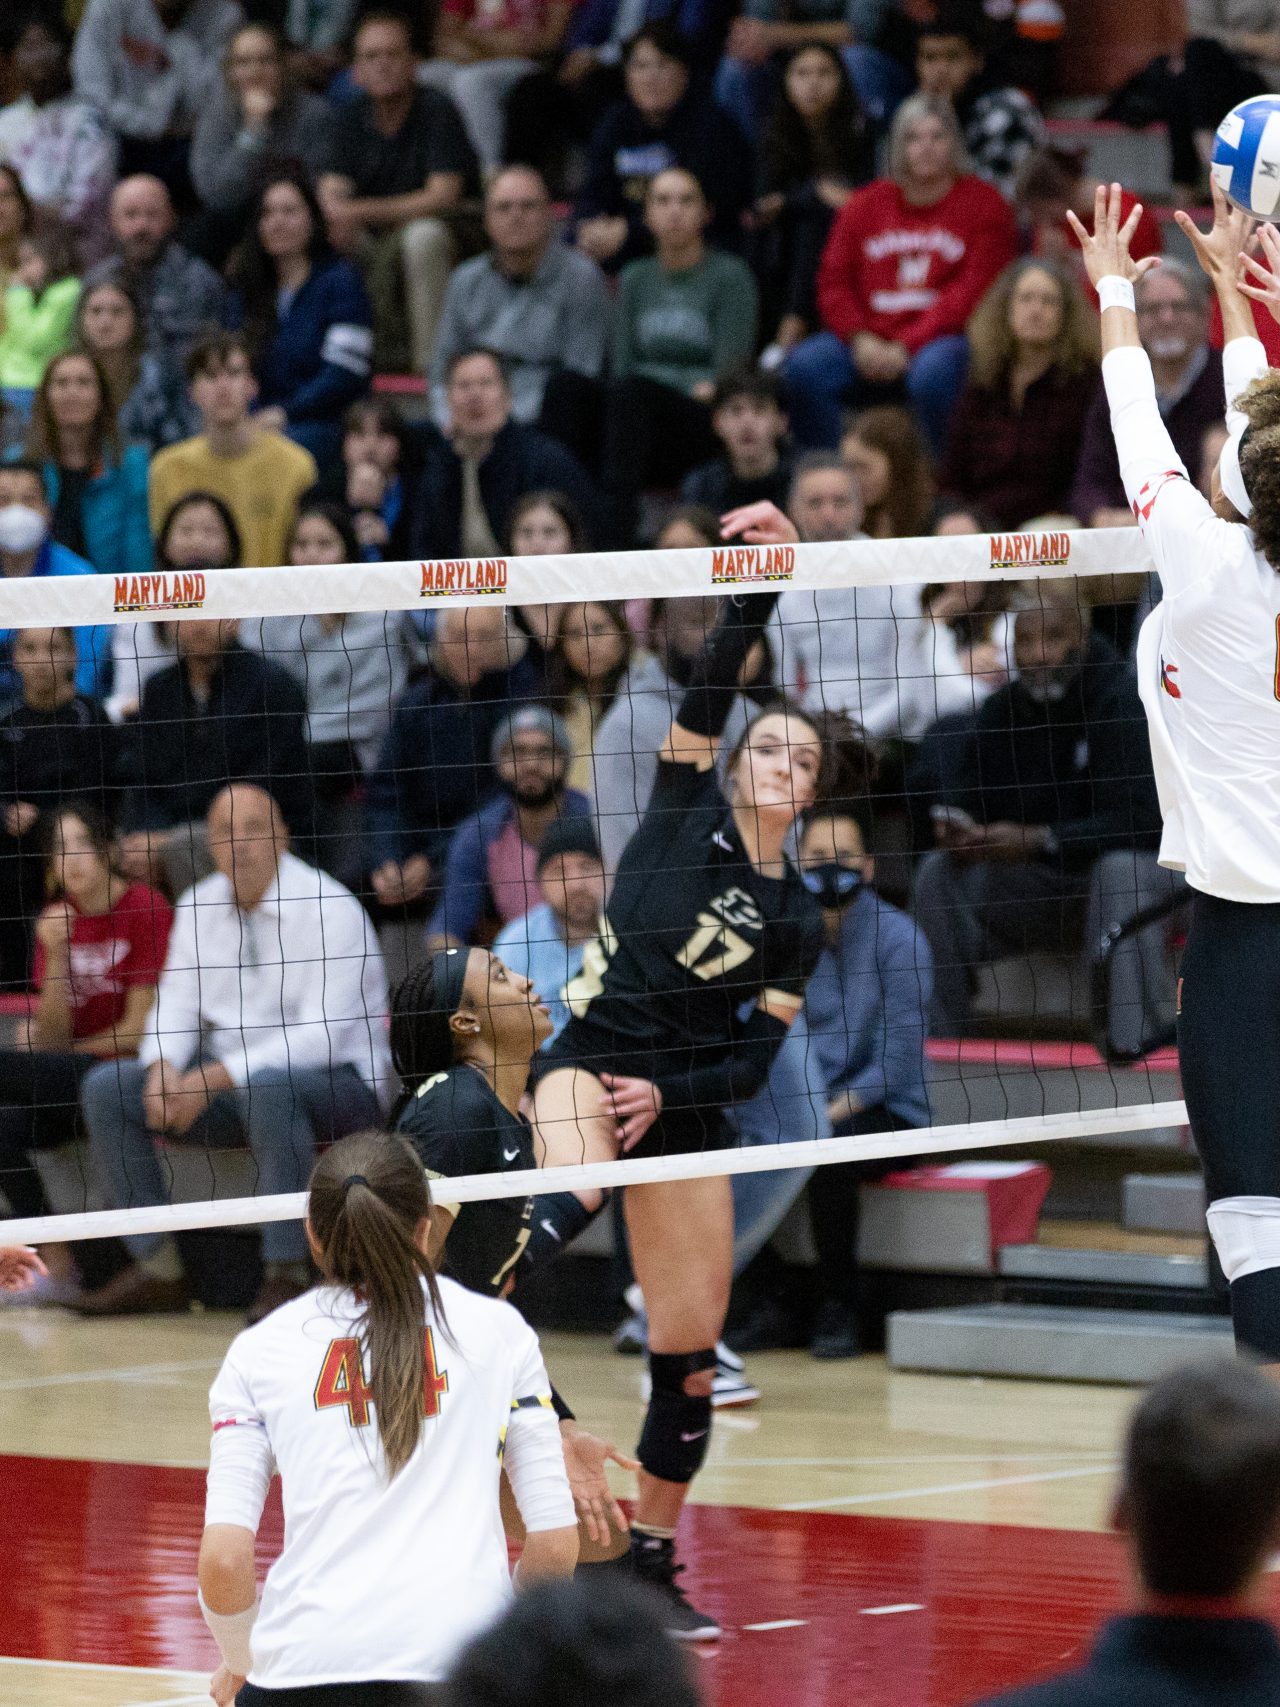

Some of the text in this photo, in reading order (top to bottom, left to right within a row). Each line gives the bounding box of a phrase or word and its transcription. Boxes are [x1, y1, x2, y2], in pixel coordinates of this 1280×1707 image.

[711, 546, 796, 577] MARYLAND
[989, 533, 1071, 562] MARYLAND
[114, 573, 206, 606] MARYLAND
[420, 559, 508, 590] MARYLAND
[675, 911, 755, 981] 17
